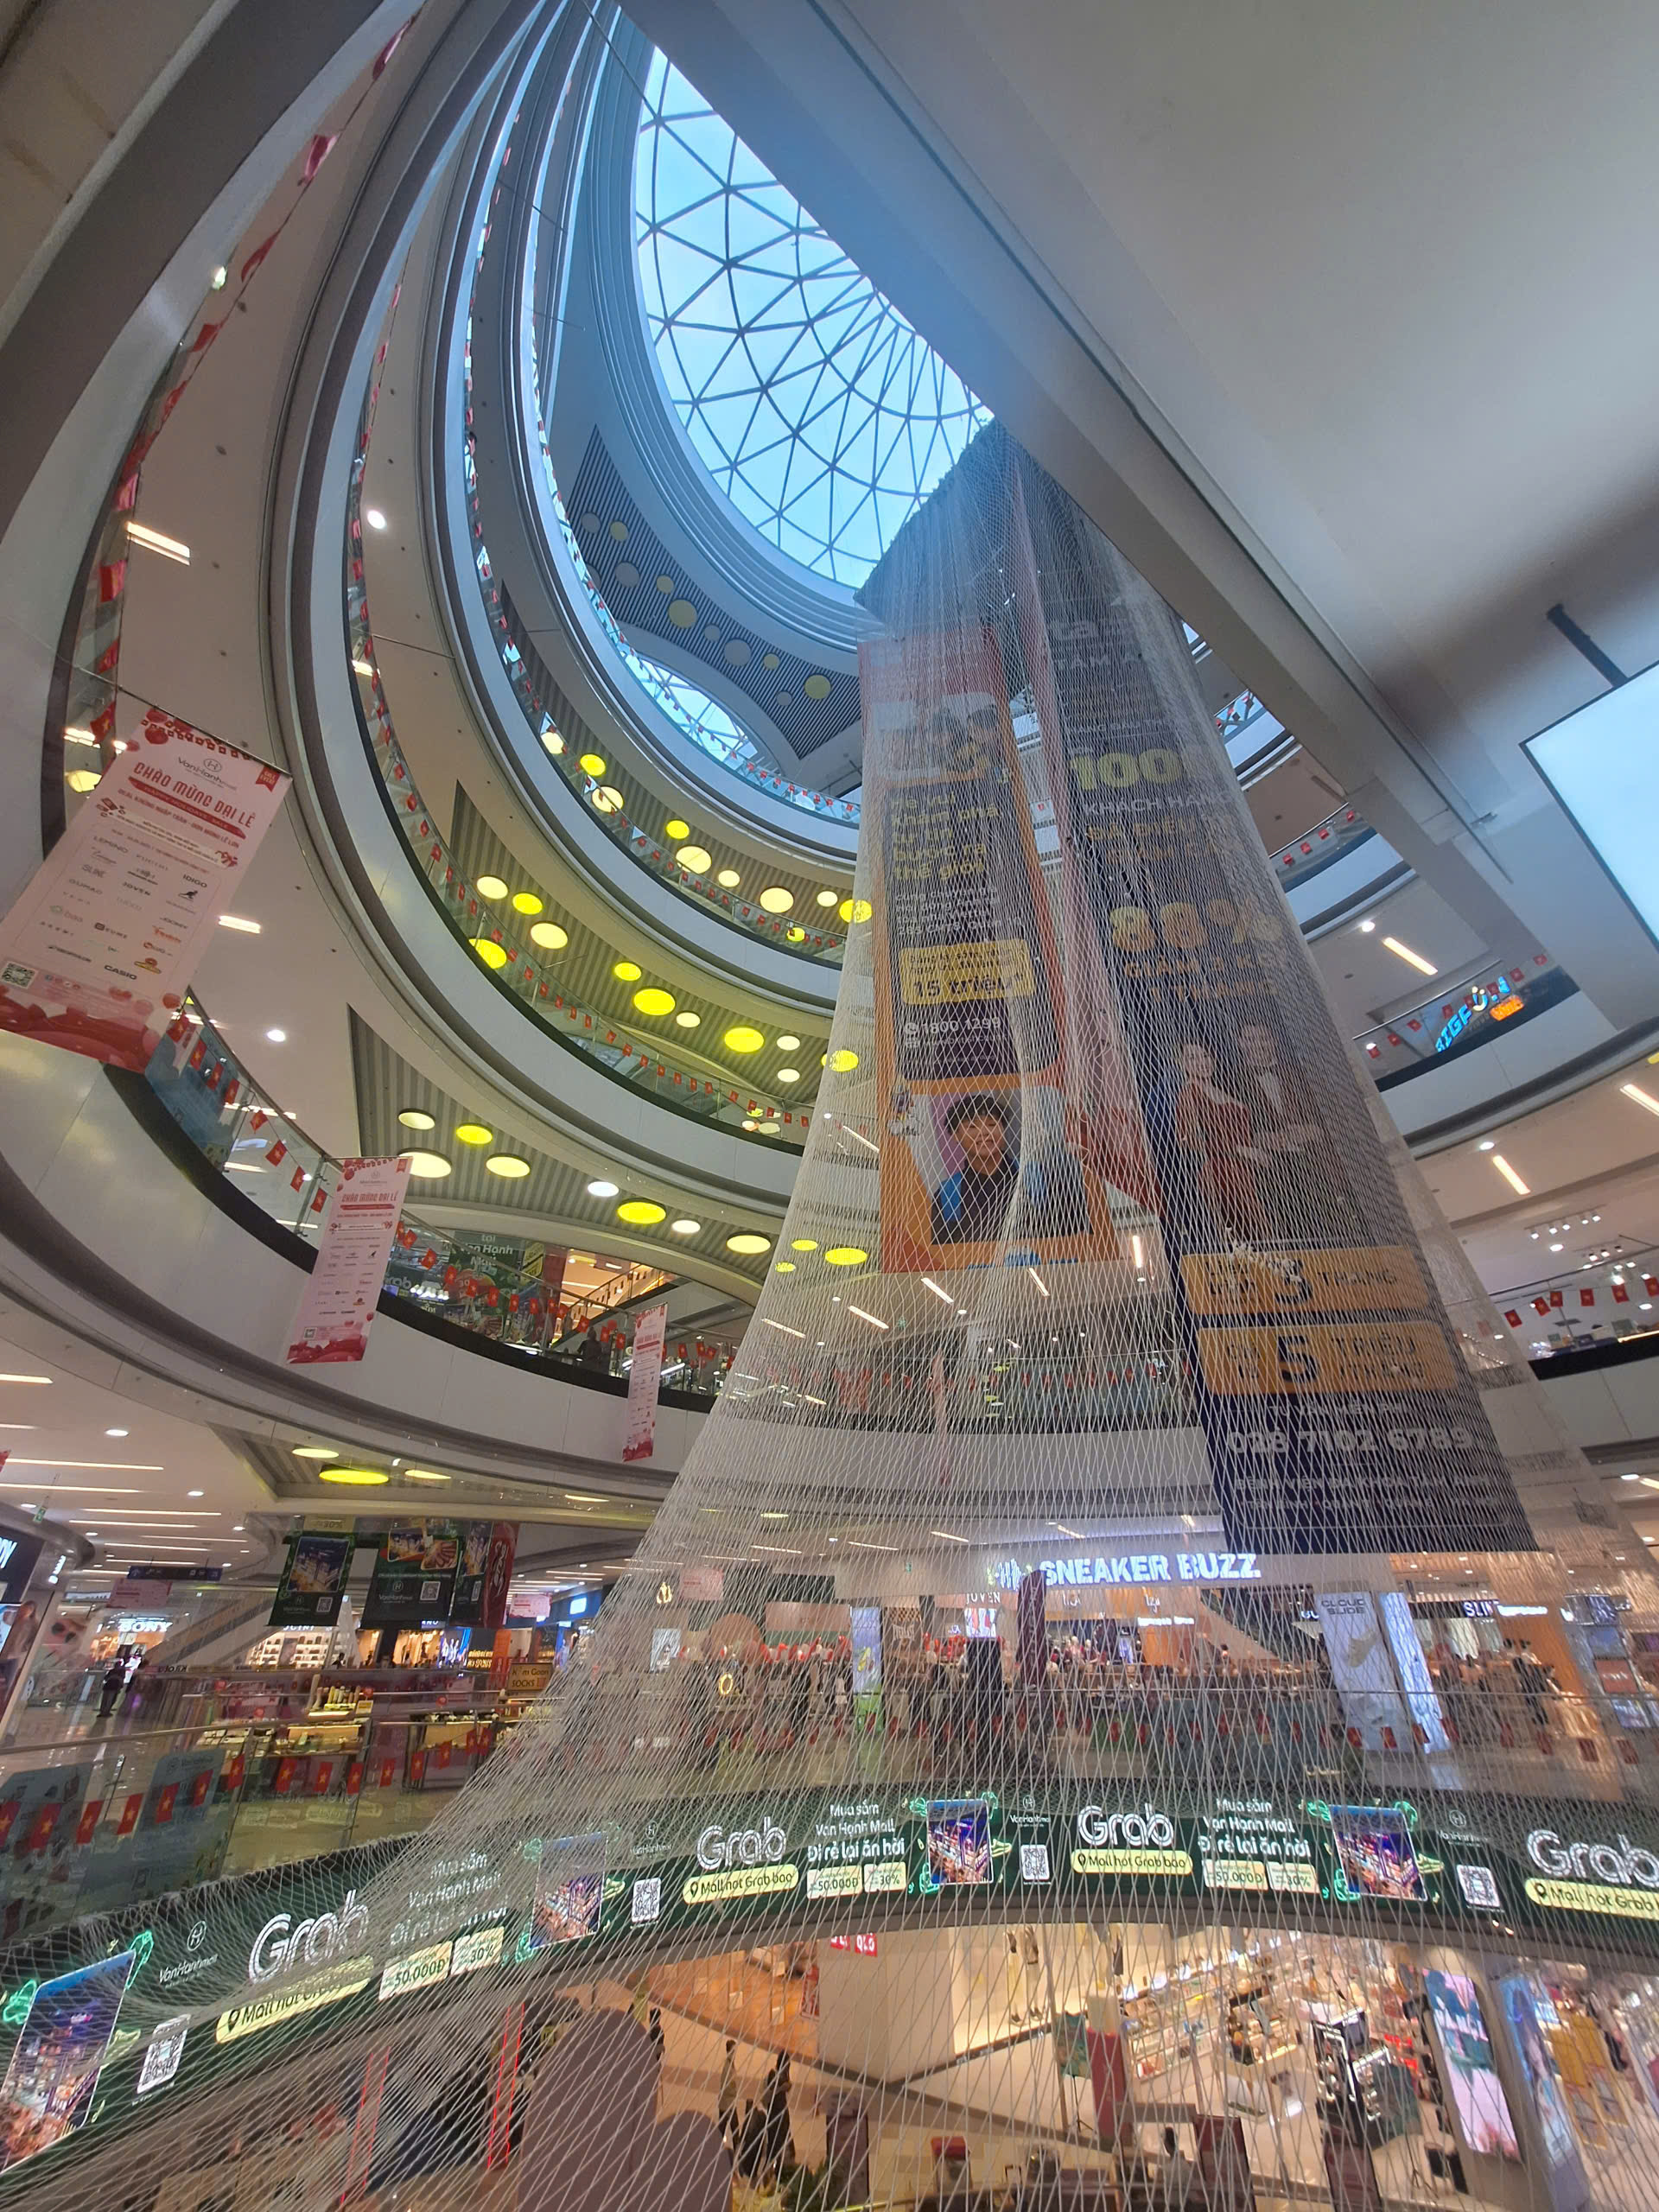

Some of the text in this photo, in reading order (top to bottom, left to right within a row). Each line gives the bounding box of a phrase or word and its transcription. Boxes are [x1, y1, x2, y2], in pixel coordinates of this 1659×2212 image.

[133, 761, 172, 787] CHÀO
[173, 784, 213, 808] MỪNG
[104, 964, 137, 980] CASIO
[913, 980, 941, 997] 15
[483, 1244, 513, 1255] Hạnh
[388, 1276, 412, 1289] rab
[1277, 1334, 1320, 1382] 5
[1300, 1428, 1380, 1452] 7102
[1387, 1427, 1473, 1451] 6789
[1039, 1553, 1262, 1586] SNEAKER BUZZ
[512, 1679, 535, 1688] SOCKS
[830, 1799, 880, 1816] Mua sắm
[1217, 1798, 1245, 1812] Mua
[839, 1820, 868, 1838] Hạnh
[870, 1817, 895, 1833] Mall
[1077, 1802, 1174, 1847] Grab
[1229, 1816, 1264, 1833] Hạnh
[1265, 1817, 1295, 1833] Mall
[696, 1816, 787, 1871] Grab
[808, 1837, 905, 1862] Đi rẻ lại ăn hời
[1260, 1836, 1282, 1855] ăn
[1089, 1855, 1112, 1867] Mall
[1115, 1855, 1133, 1867] hot
[1135, 1855, 1161, 1867] Grab
[1527, 1829, 1659, 1888] Grab
[701, 1878, 723, 1895] Mall
[745, 1874, 770, 1890] Grab
[880, 1874, 899, 1885] 30%
[1549, 1886, 1654, 1911] Mall hot Grab
[249, 1889, 369, 1985] Grab
[471, 1944, 494, 1961] 30%
[241, 1999, 274, 2025] Mall
